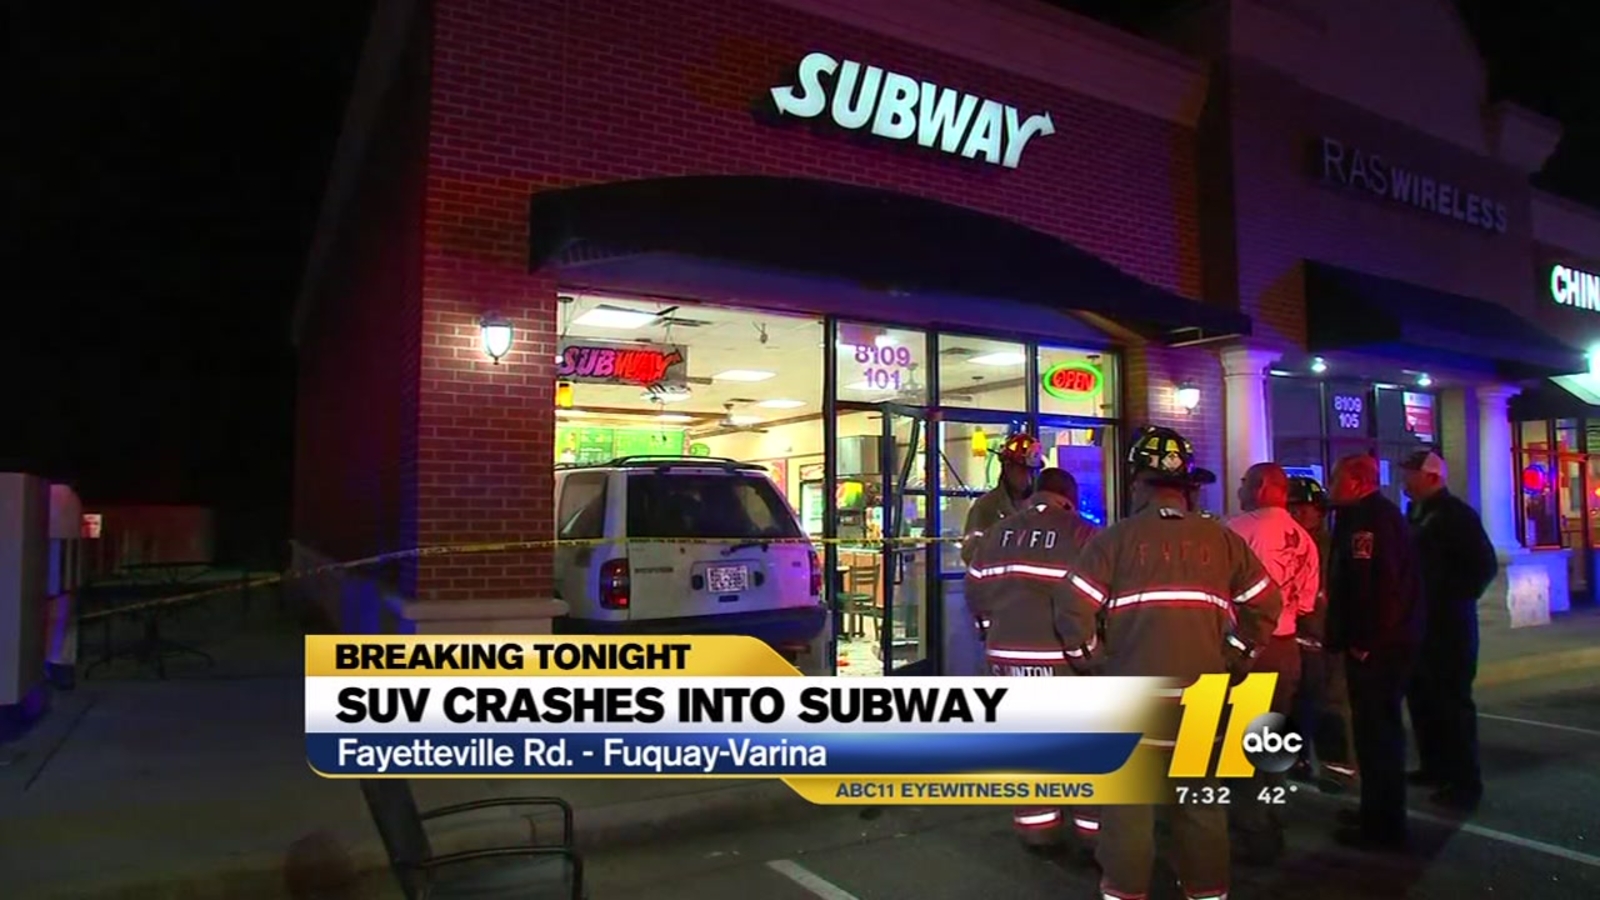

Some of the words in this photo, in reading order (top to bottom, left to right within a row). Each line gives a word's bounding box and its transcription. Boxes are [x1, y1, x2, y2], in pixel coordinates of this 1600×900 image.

[770, 52, 1055, 169] SUBWAY
[1322, 136, 1388, 196] RAS
[1390, 165, 1508, 234] WIRELESS
[1551, 264, 1600, 312] CHIN
[557, 345, 682, 384] SUBWAY
[854, 344, 910, 366] 8109
[863, 367, 900, 390] 101
[1053, 369, 1095, 391] OPEN
[1334, 396, 1362, 412] 8109
[1002, 530, 1056, 549] FYFD
